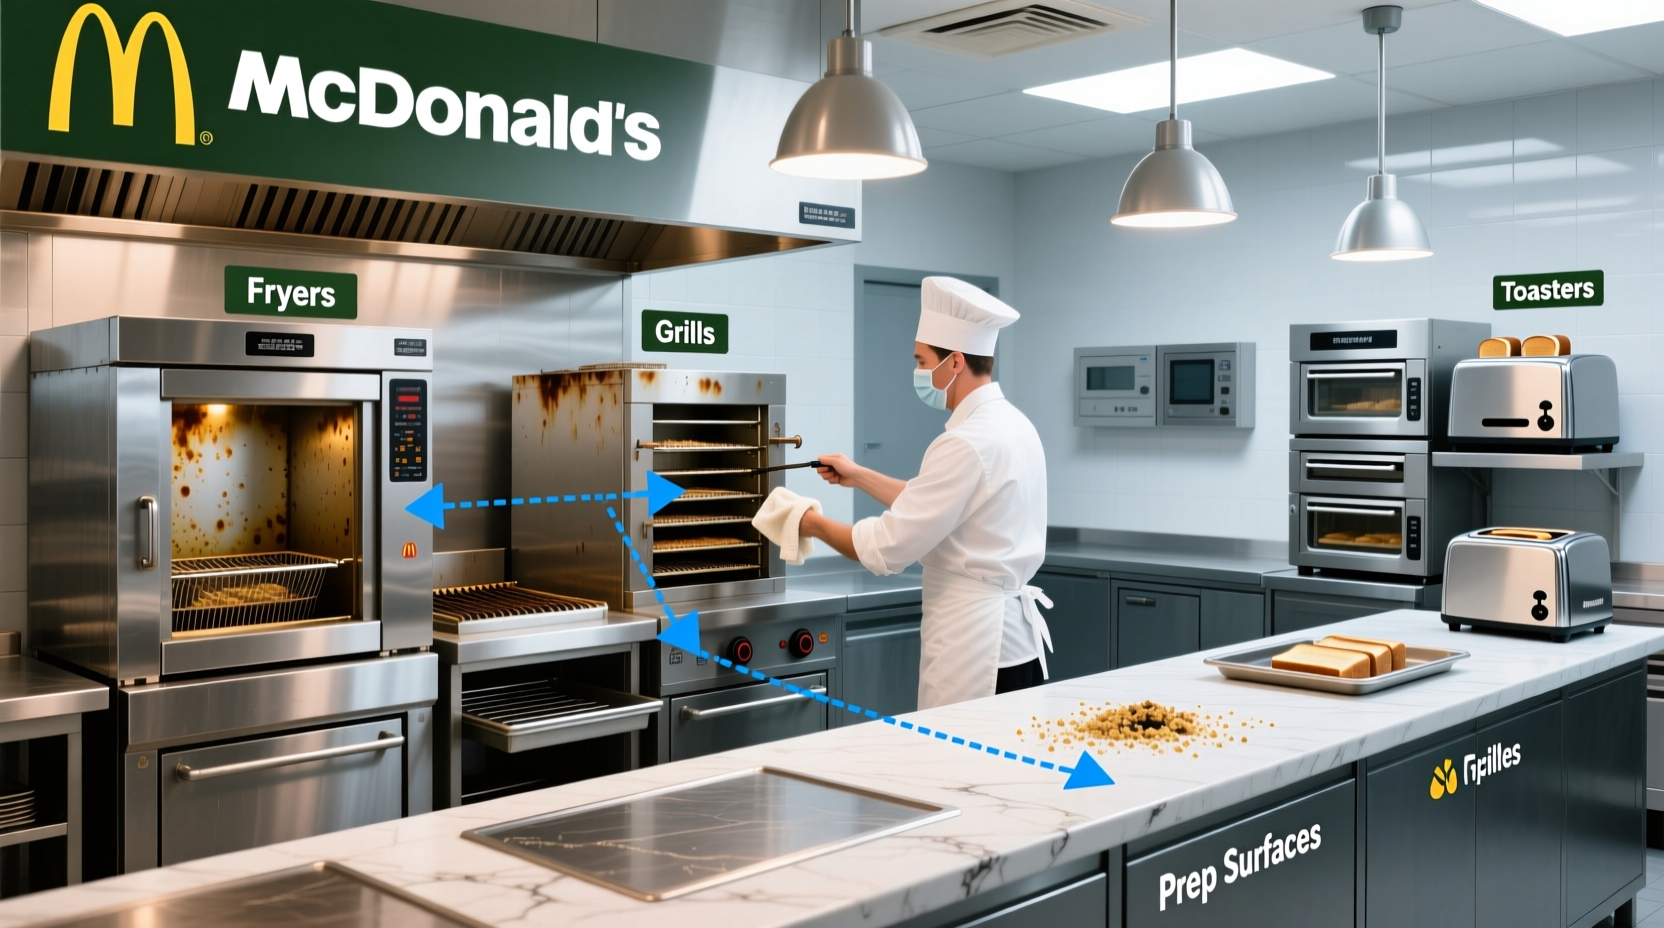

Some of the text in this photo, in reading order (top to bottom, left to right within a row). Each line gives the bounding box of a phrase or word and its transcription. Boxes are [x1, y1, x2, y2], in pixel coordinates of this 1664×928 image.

[228, 49, 662, 162] McDonald's
[247, 276, 336, 312] Fryers
[1500, 279, 1595, 302] Toasters
[655, 319, 716, 345] Grills
[1159, 822, 1322, 912] Prep Surfaces
